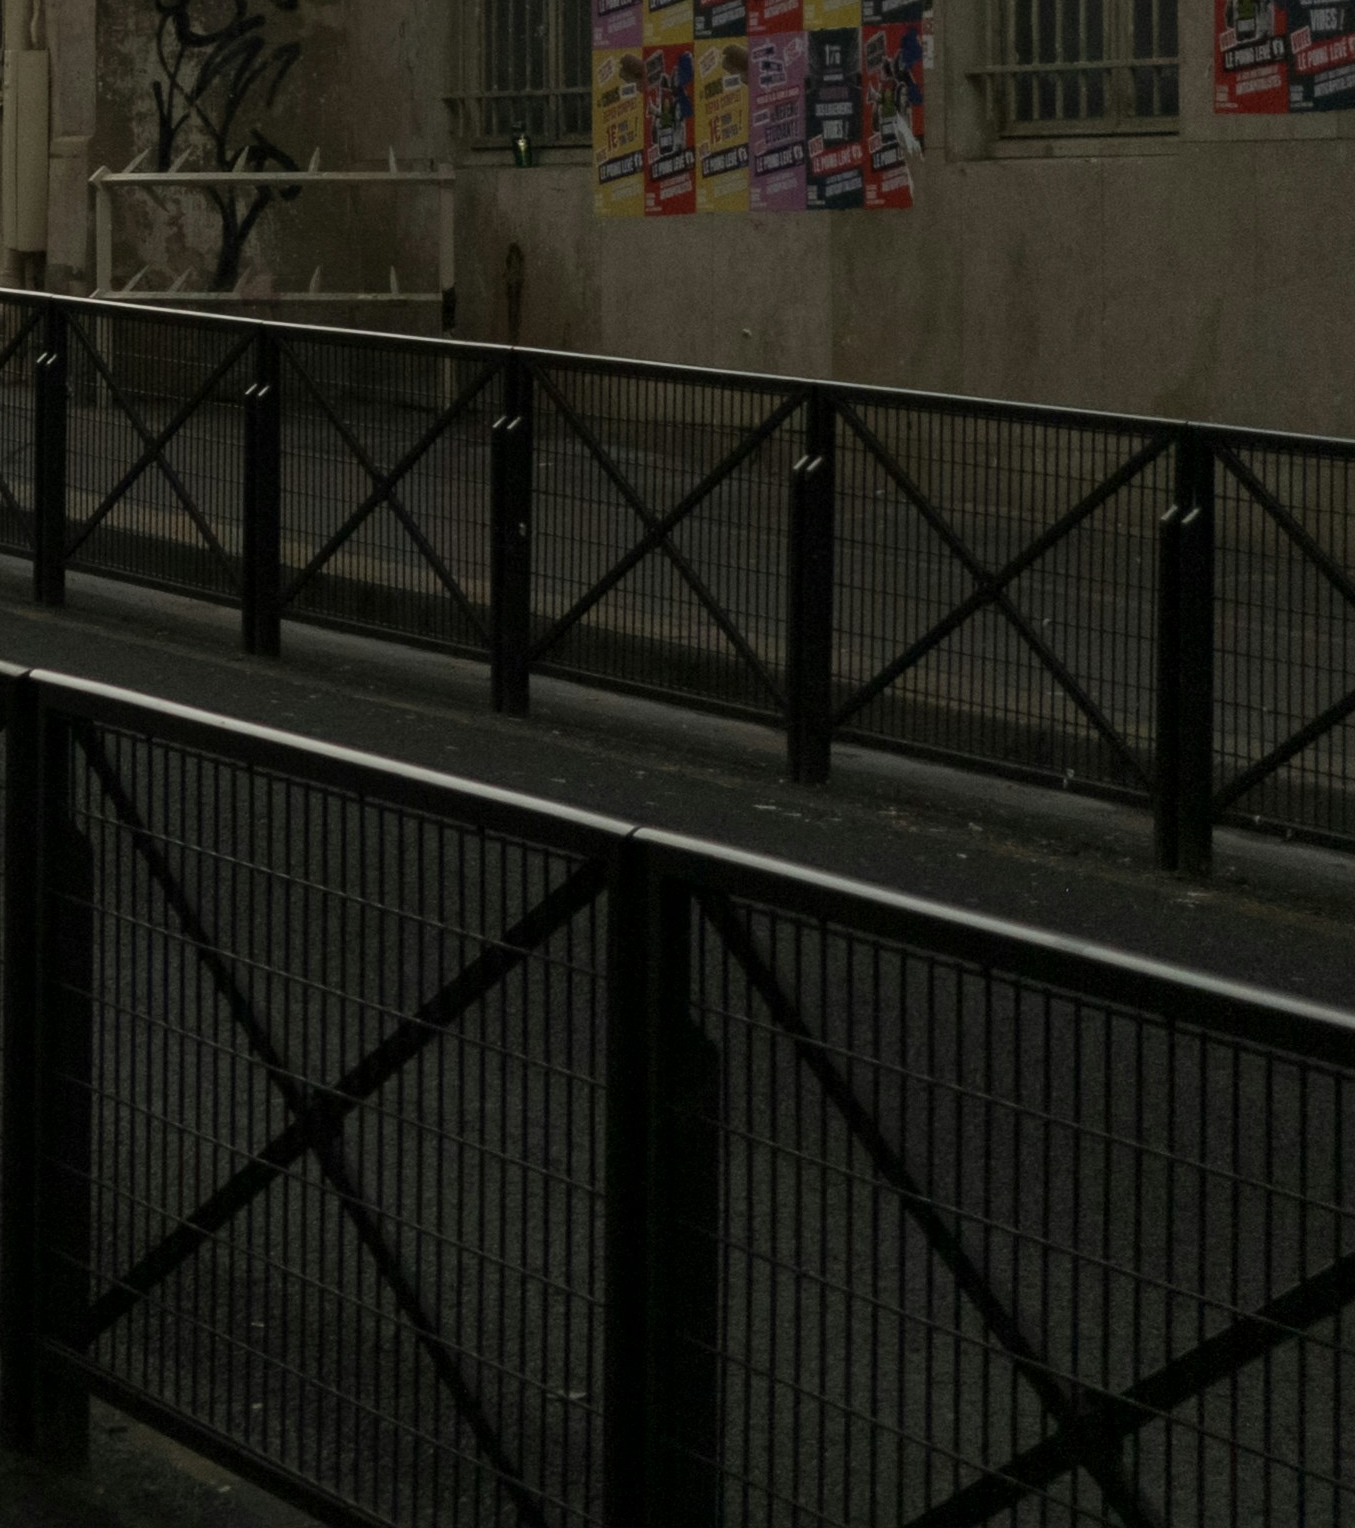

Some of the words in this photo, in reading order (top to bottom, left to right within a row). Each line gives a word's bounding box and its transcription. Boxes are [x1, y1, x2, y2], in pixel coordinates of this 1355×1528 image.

[1309, 7, 1337, 31] VIDES
[1225, 51, 1233, 69] LE
[1297, 51, 1307, 70] LE
